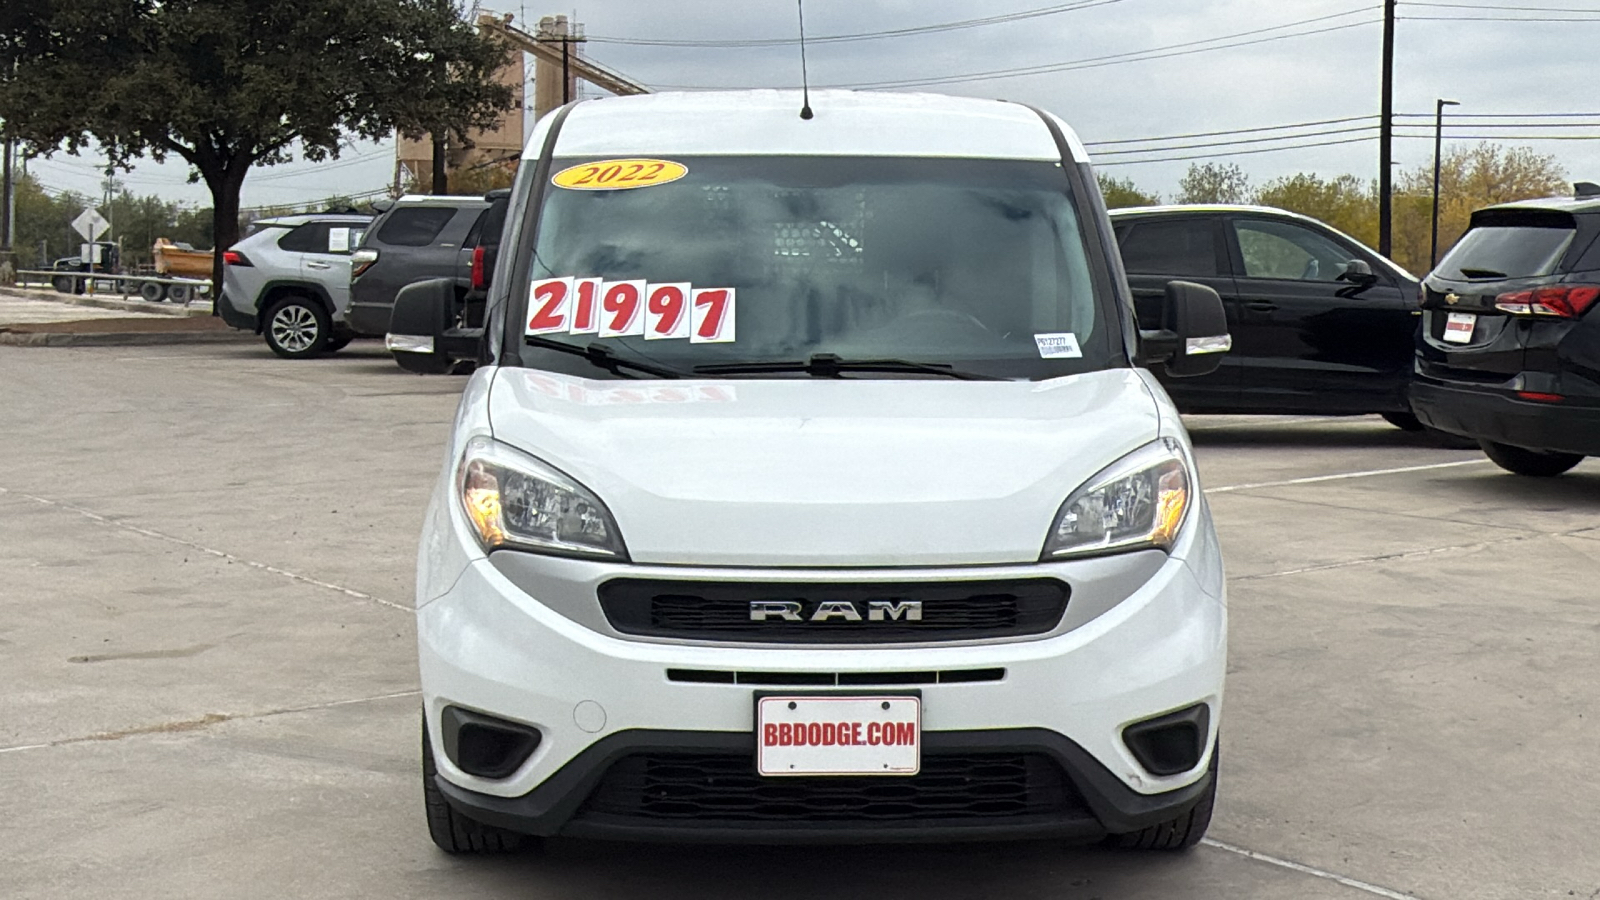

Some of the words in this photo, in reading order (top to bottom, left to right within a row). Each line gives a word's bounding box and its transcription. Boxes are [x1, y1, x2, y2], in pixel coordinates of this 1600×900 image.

[573, 163, 665, 185] 2022
[529, 281, 731, 338] 21997
[749, 601, 922, 621] RAM
[764, 722, 915, 747] BBDODGE.COM
